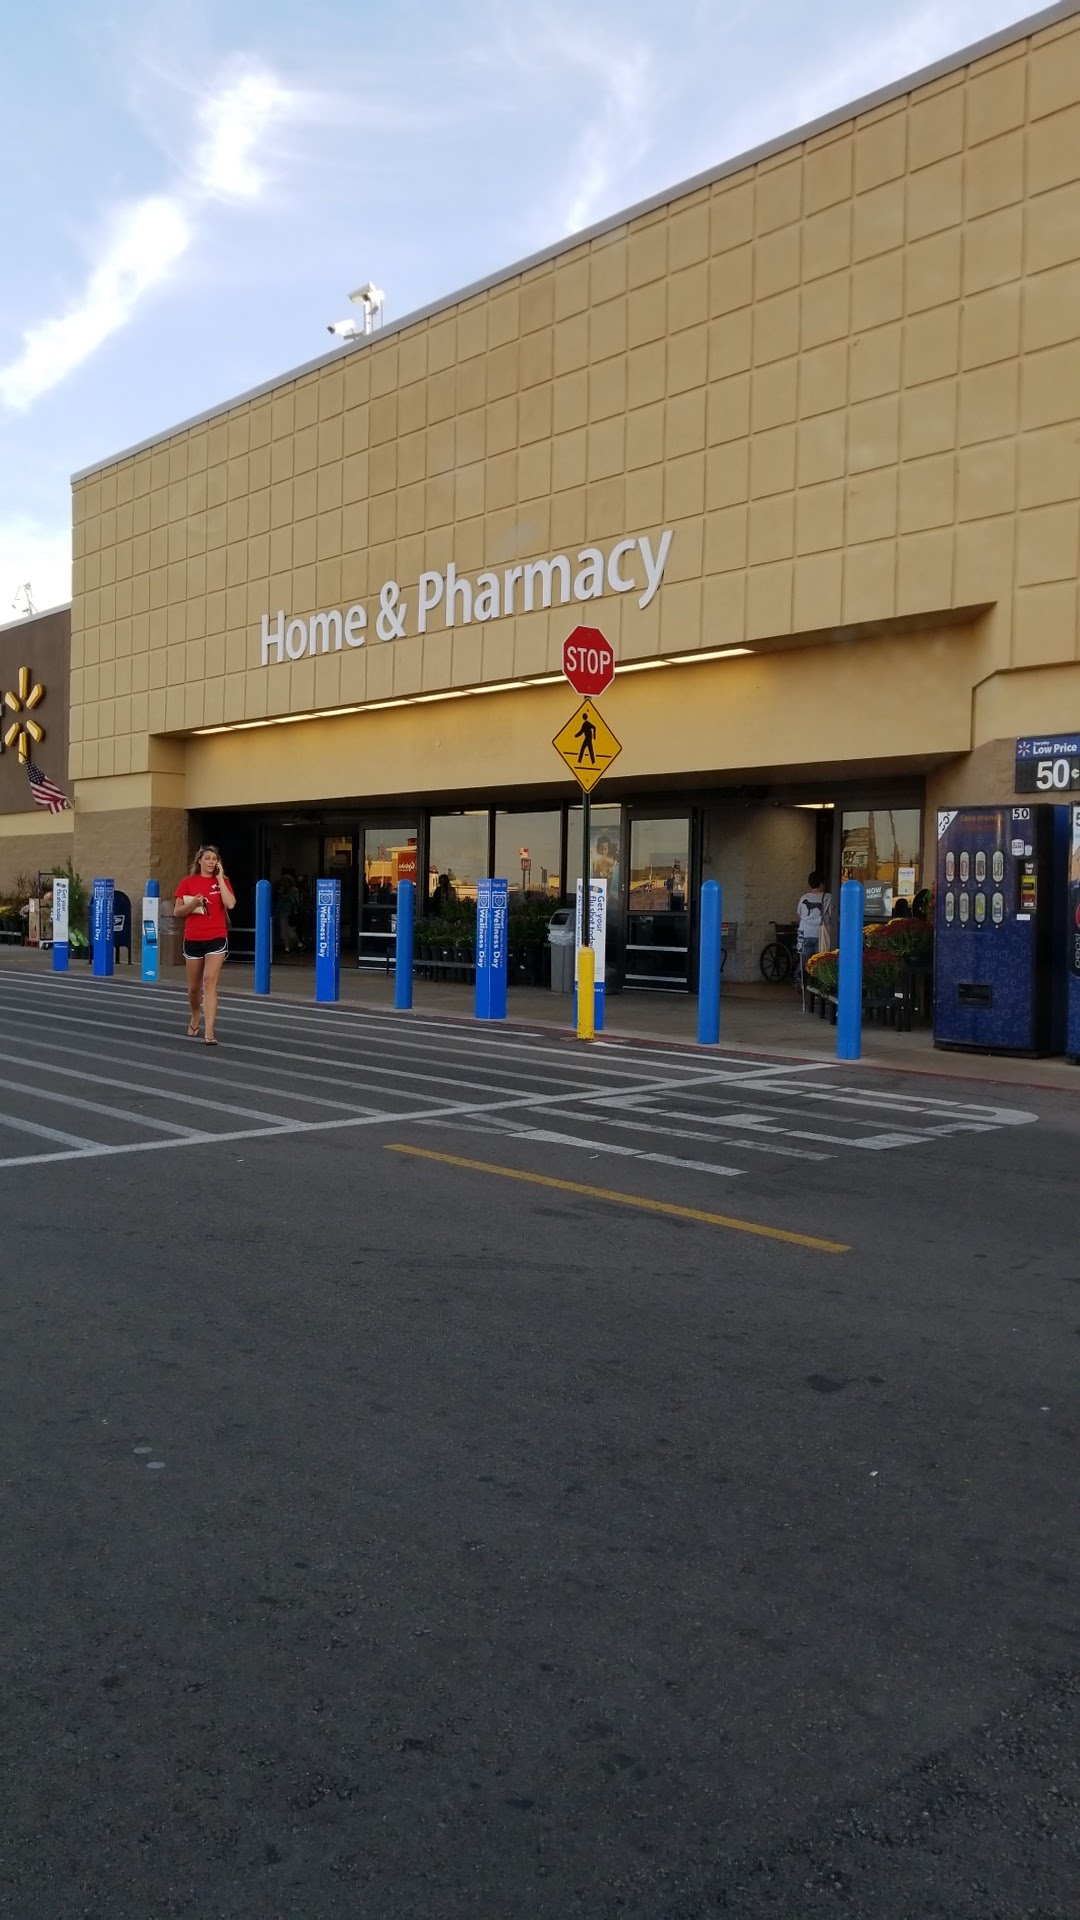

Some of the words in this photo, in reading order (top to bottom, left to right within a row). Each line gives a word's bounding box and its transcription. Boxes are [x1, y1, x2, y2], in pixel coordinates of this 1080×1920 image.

[260, 604, 368, 666] Home
[375, 580, 408, 642] &
[417, 530, 674, 634] Pharmacy
[566, 646, 611, 675] STOP
[1032, 746, 1053, 755] Low
[1053, 743, 1078, 753] Price
[1013, 808, 1029, 819] 50
[597, 895, 605, 911] Get
[595, 913, 603, 933] your
[318, 943, 327, 958] Day
[492, 952, 500, 968] Day
